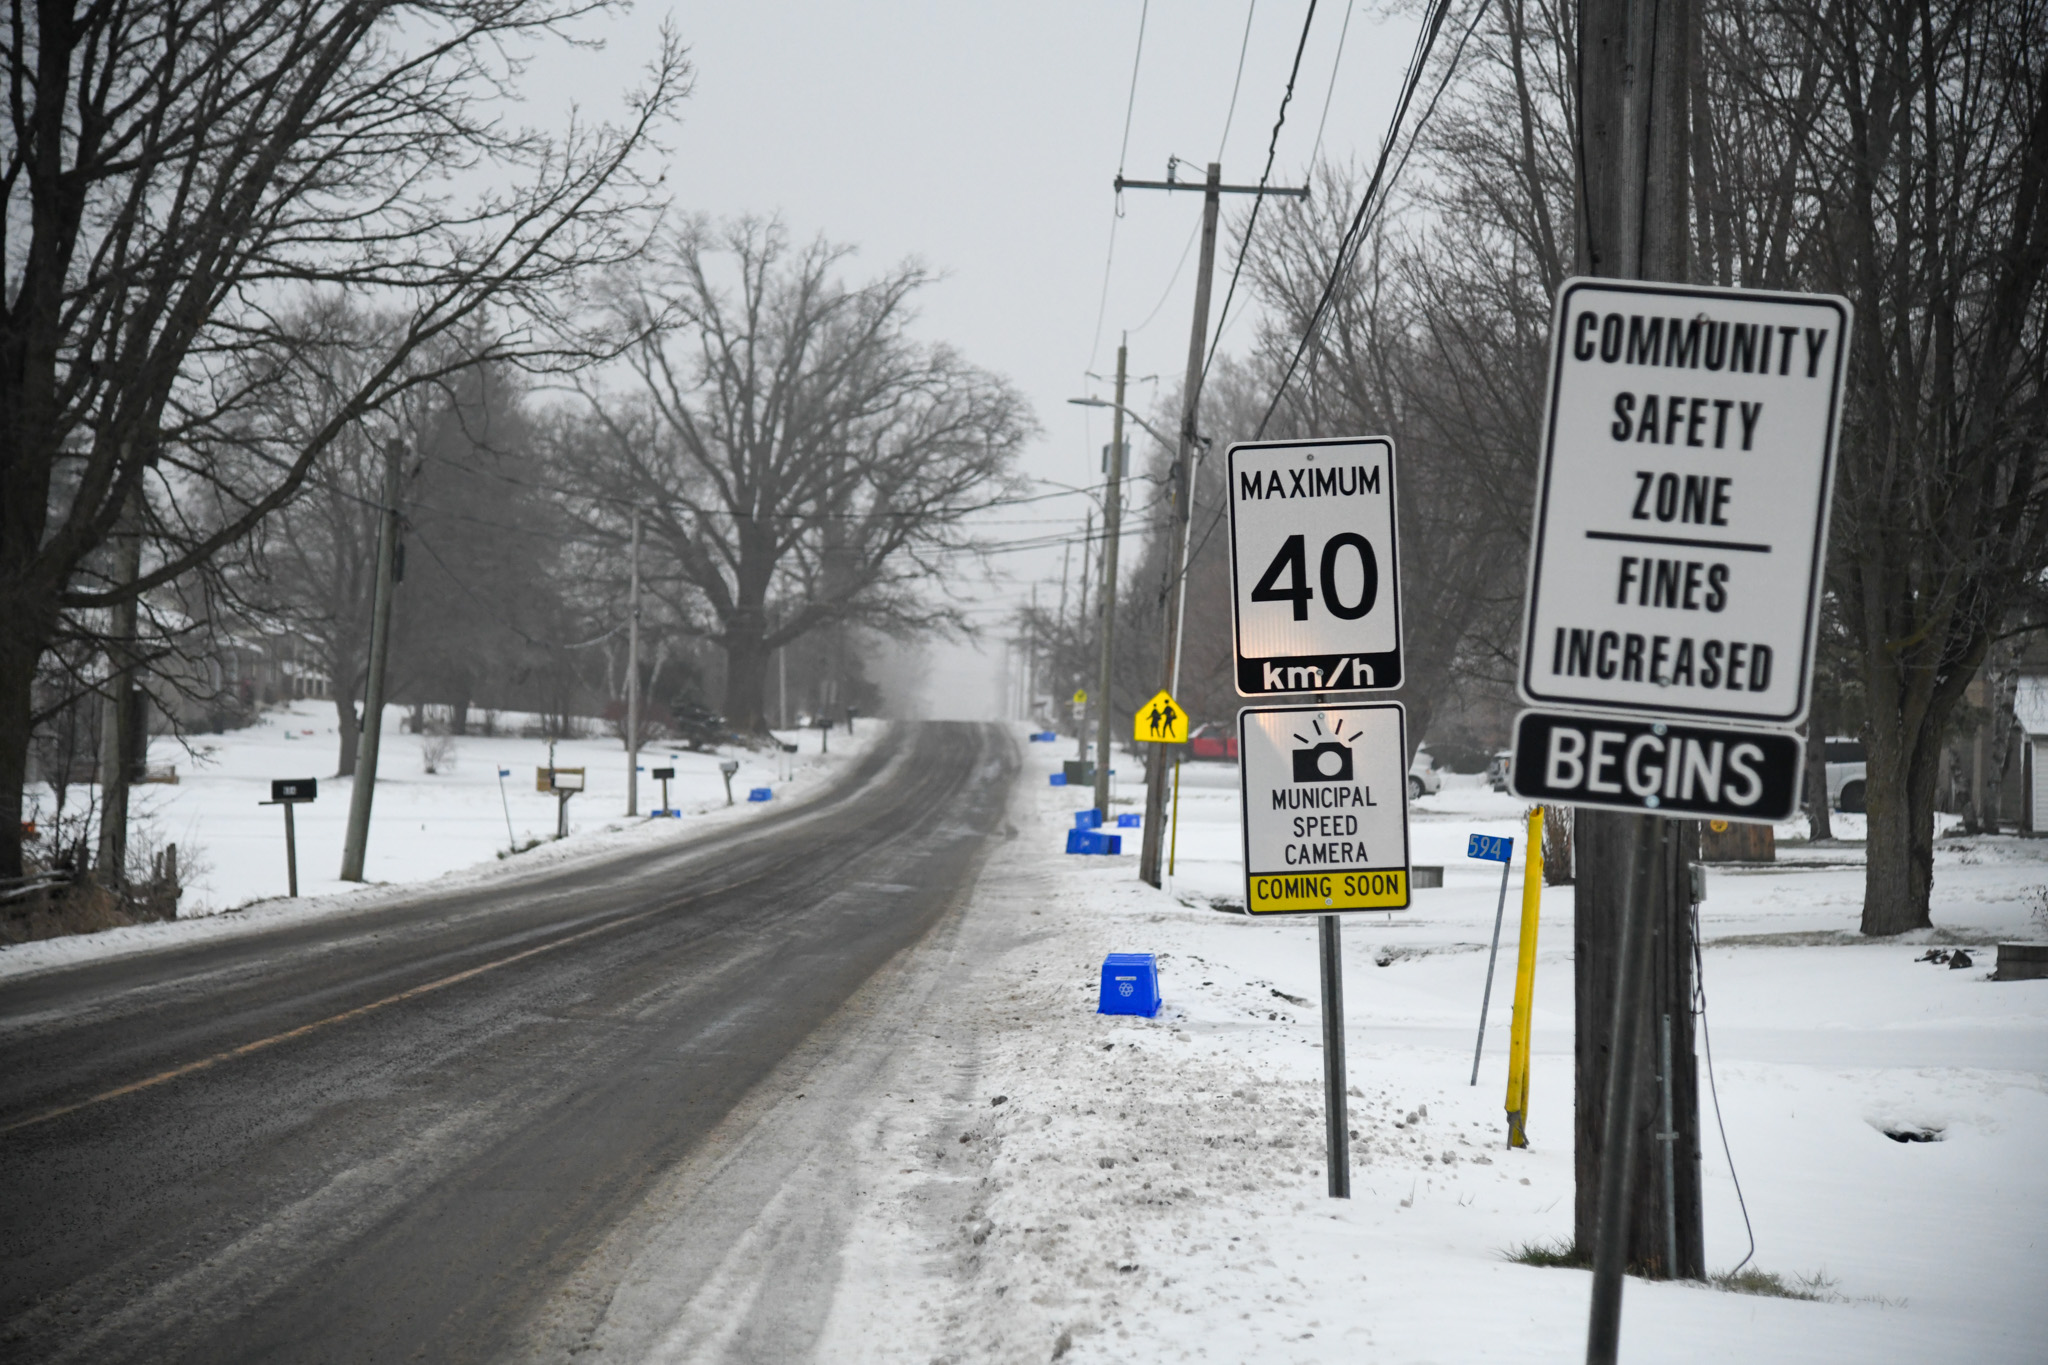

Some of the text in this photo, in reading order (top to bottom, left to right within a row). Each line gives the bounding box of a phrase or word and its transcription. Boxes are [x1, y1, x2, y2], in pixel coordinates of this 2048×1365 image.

[1573, 311, 1829, 378] COMMUNITY
[1611, 391, 1763, 451] SAFETY
[1240, 465, 1380, 500] MAXIMUM
[1632, 471, 1732, 527] ZONE
[1251, 532, 1378, 621] 40
[1616, 556, 1730, 613] FINES
[1263, 657, 1375, 690] km/h
[1552, 627, 1773, 693] INCREASED
[1545, 726, 1765, 807] BEGINS
[1272, 786, 1377, 810] MUNICIPAL
[1293, 815, 1358, 838] SPEED
[1468, 835, 1501, 859] 594
[1285, 842, 1368, 865] CAMERA
[1257, 874, 1399, 899] COMING SOON
